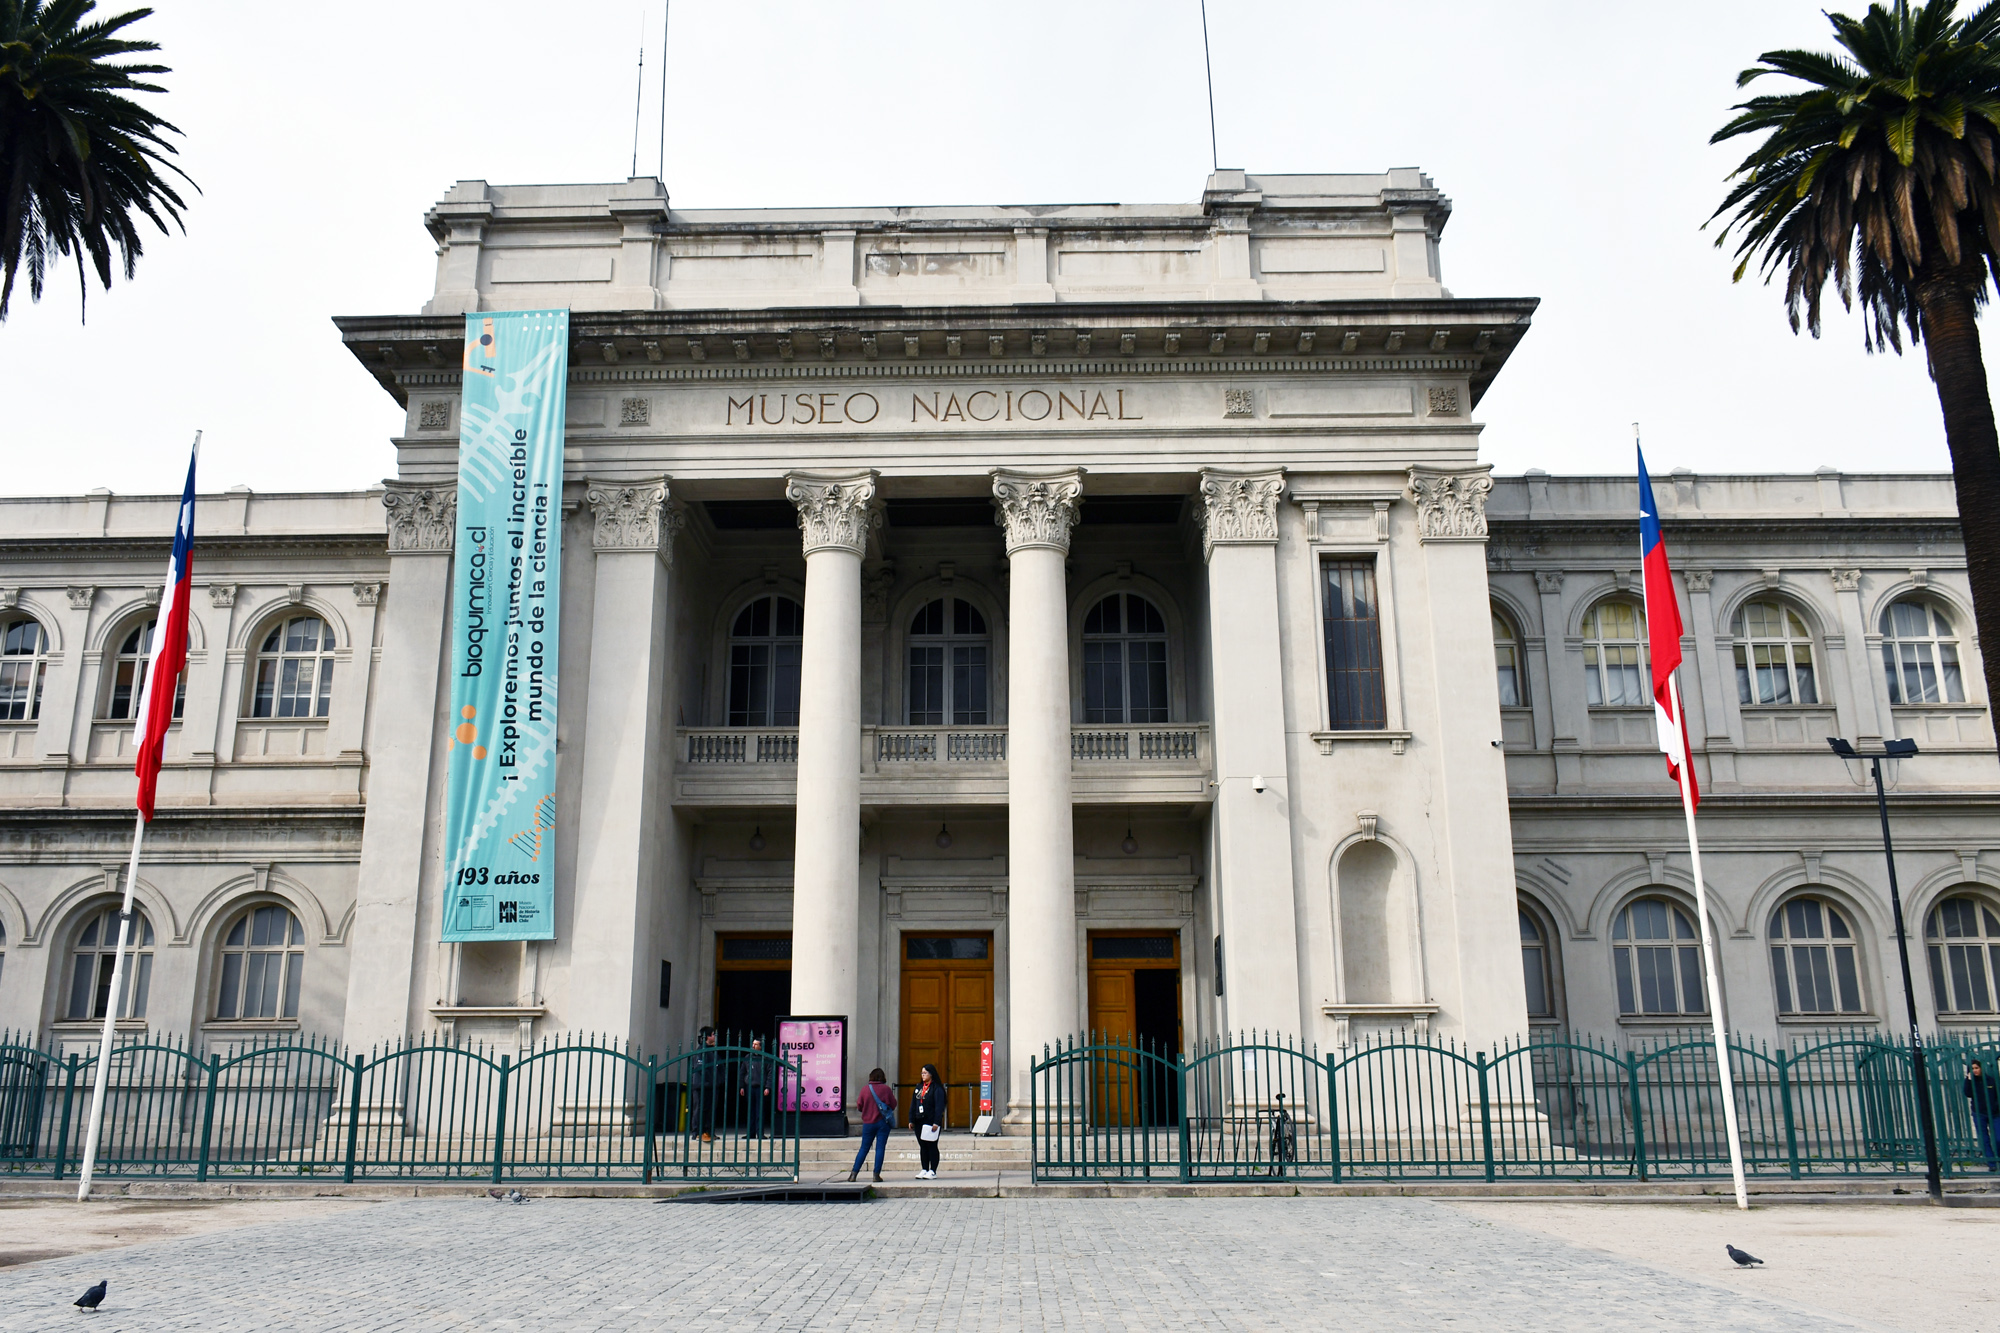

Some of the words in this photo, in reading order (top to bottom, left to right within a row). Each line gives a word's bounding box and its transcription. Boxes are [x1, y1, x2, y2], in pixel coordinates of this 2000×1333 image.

[726, 391, 880, 426] MUSEO
[911, 388, 1143, 422] NACIONAL
[507, 428, 527, 523] increíble
[507, 530, 524, 549] el
[528, 495, 548, 573] ciencia
[504, 556, 524, 628] juntos
[528, 580, 546, 599] la
[527, 605, 545, 633] de
[526, 640, 544, 721] mundo
[499, 632, 520, 767] Exploremos
[457, 867, 489, 886] 193
[494, 870, 540, 885] años
[499, 901, 517, 912] MN
[499, 912, 517, 923] HN
[781, 1042, 815, 1050] MUSEO
